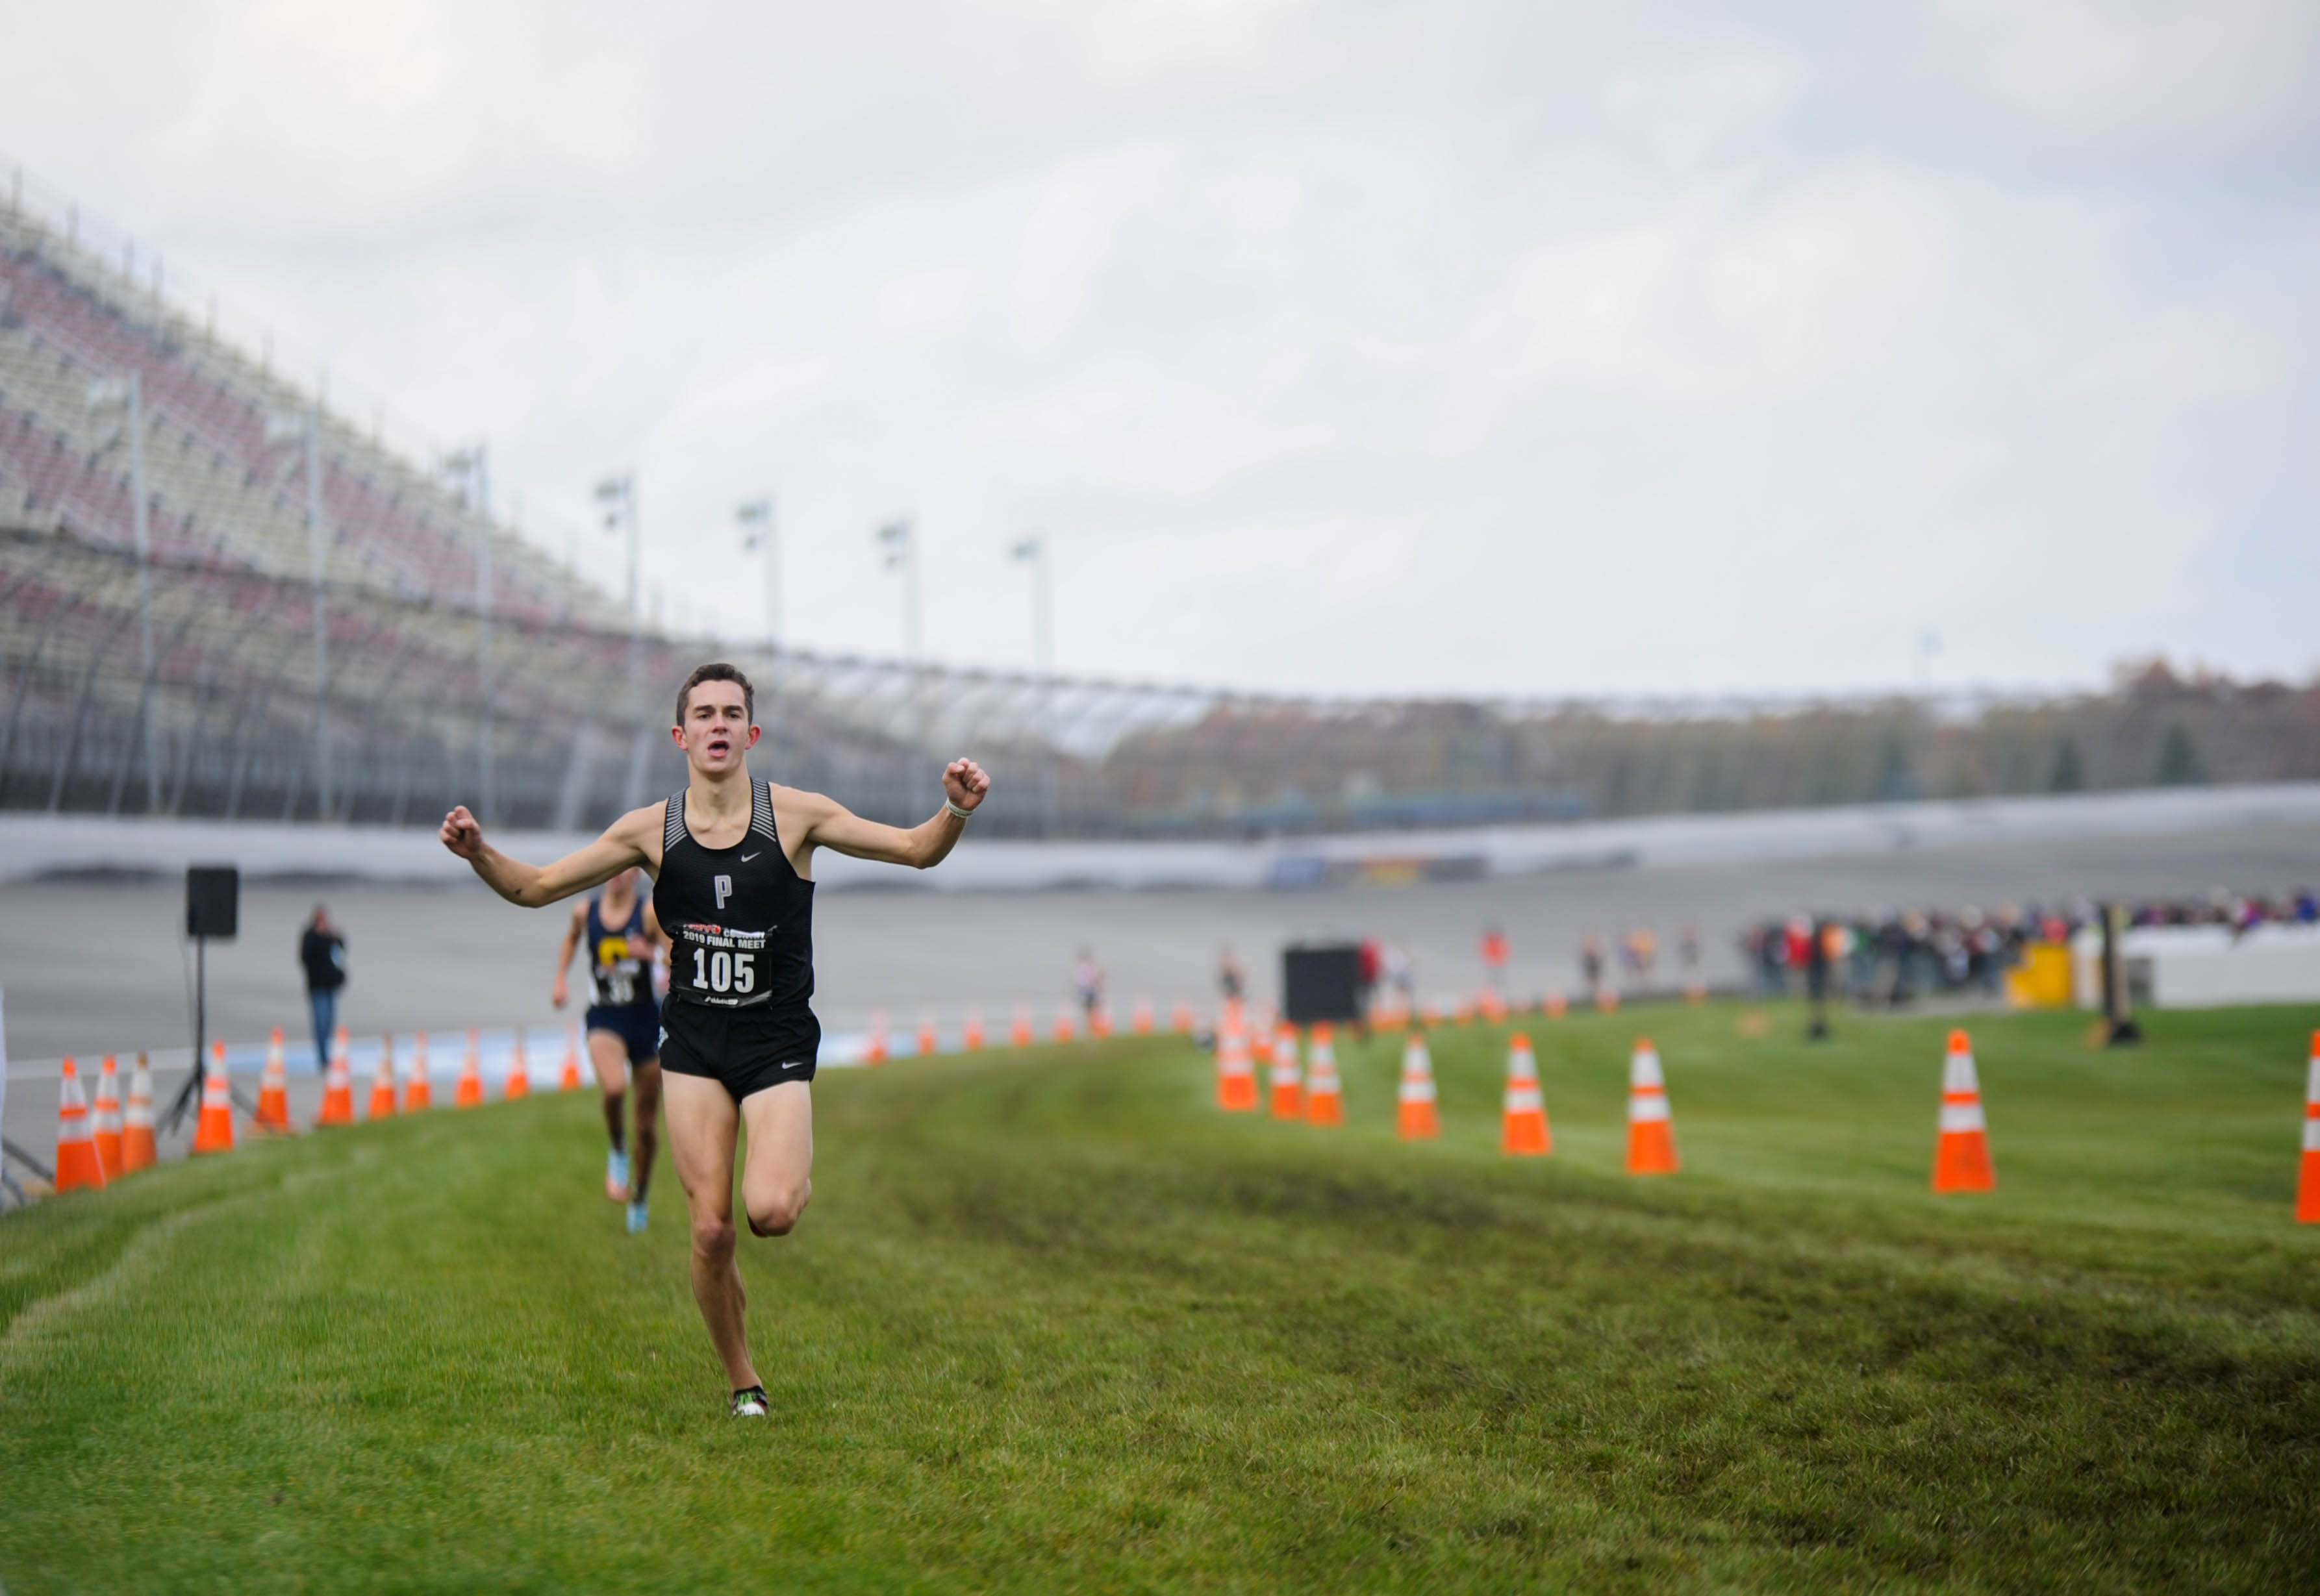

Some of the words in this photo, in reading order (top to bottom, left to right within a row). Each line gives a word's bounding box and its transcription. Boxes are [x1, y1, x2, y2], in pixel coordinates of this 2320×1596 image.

[714, 875, 732, 909] P
[683, 930, 705, 943] 2019
[707, 936, 735, 948] FINAL
[738, 939, 766, 949] MEET
[693, 947, 755, 993] 105
